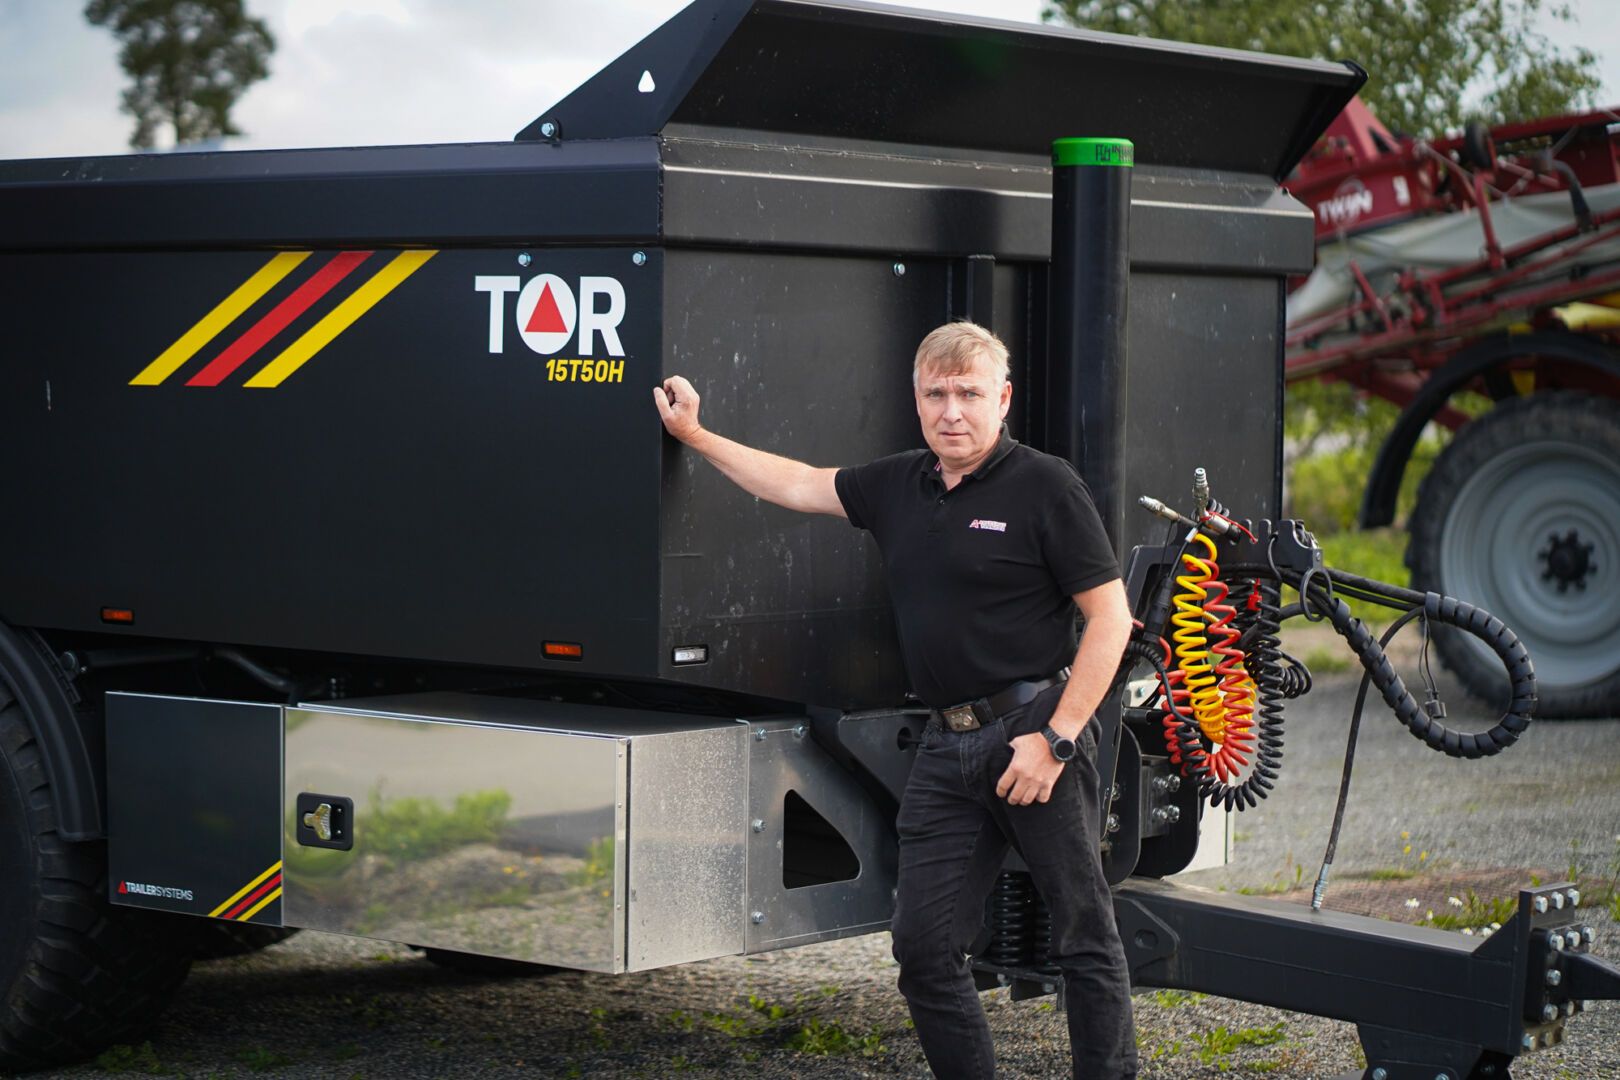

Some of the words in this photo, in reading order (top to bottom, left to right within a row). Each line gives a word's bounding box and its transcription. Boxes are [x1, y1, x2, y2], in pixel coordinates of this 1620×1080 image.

[475, 273, 626, 356] TOR
[545, 359, 625, 382] 15T50H
[125, 881, 193, 901] TRAILERSYSTEMS
